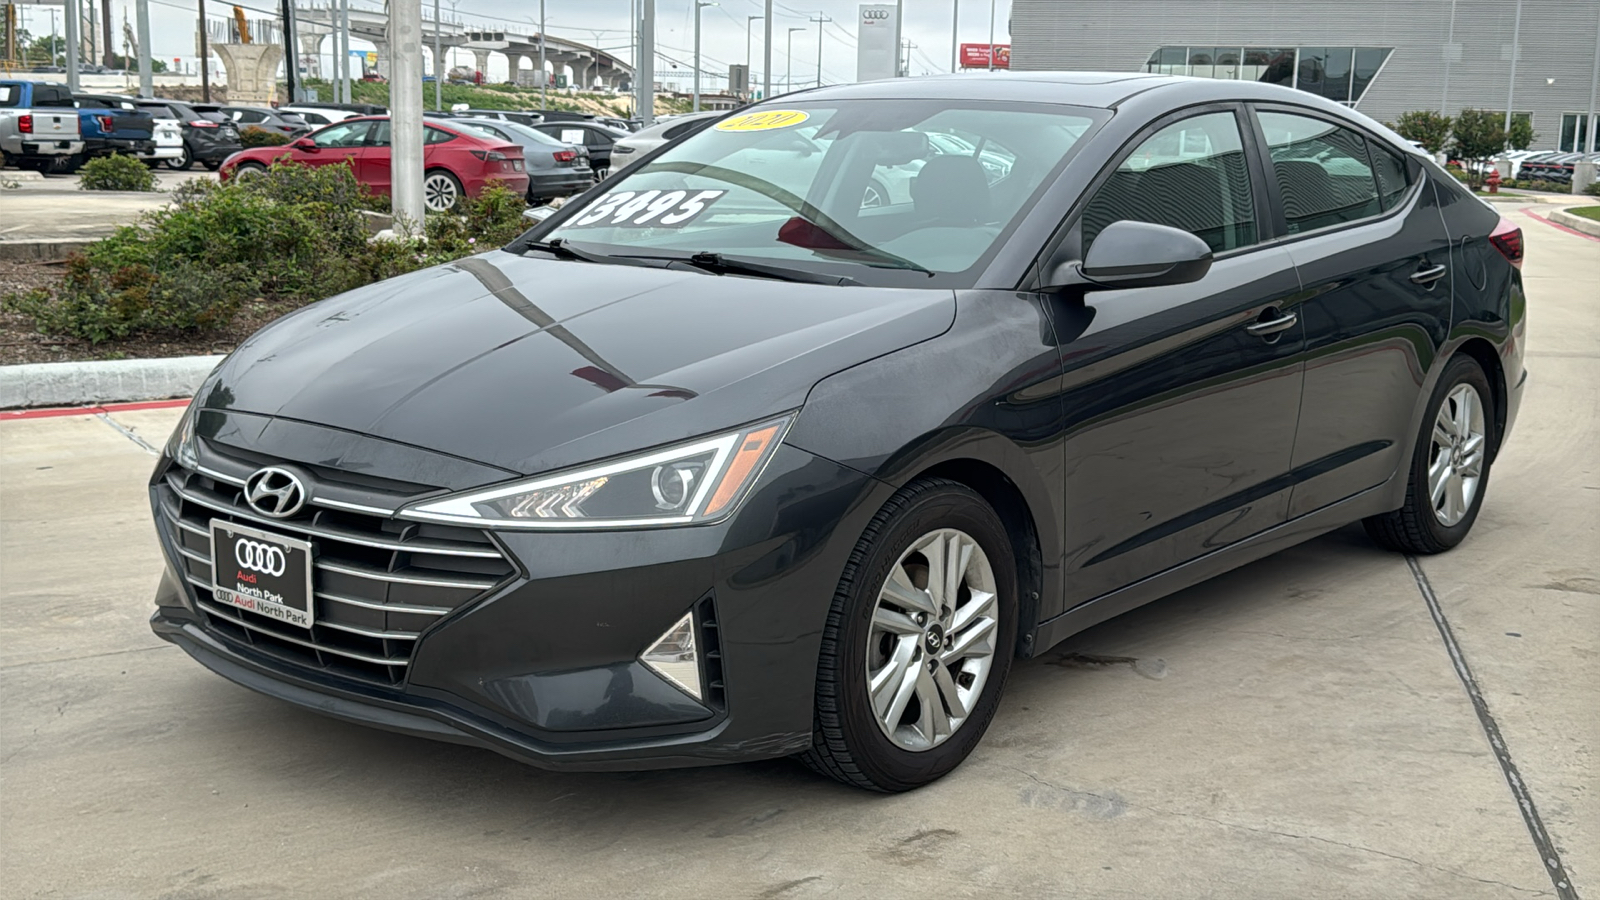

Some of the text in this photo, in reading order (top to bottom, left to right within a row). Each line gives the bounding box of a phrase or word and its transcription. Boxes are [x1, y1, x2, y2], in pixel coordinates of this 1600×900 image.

[722, 113, 799, 128] 2020
[561, 189, 724, 228] 13495
[236, 570, 257, 584] Audi
[236, 582, 284, 604] North Park
[234, 594, 308, 625] Audi North Park
